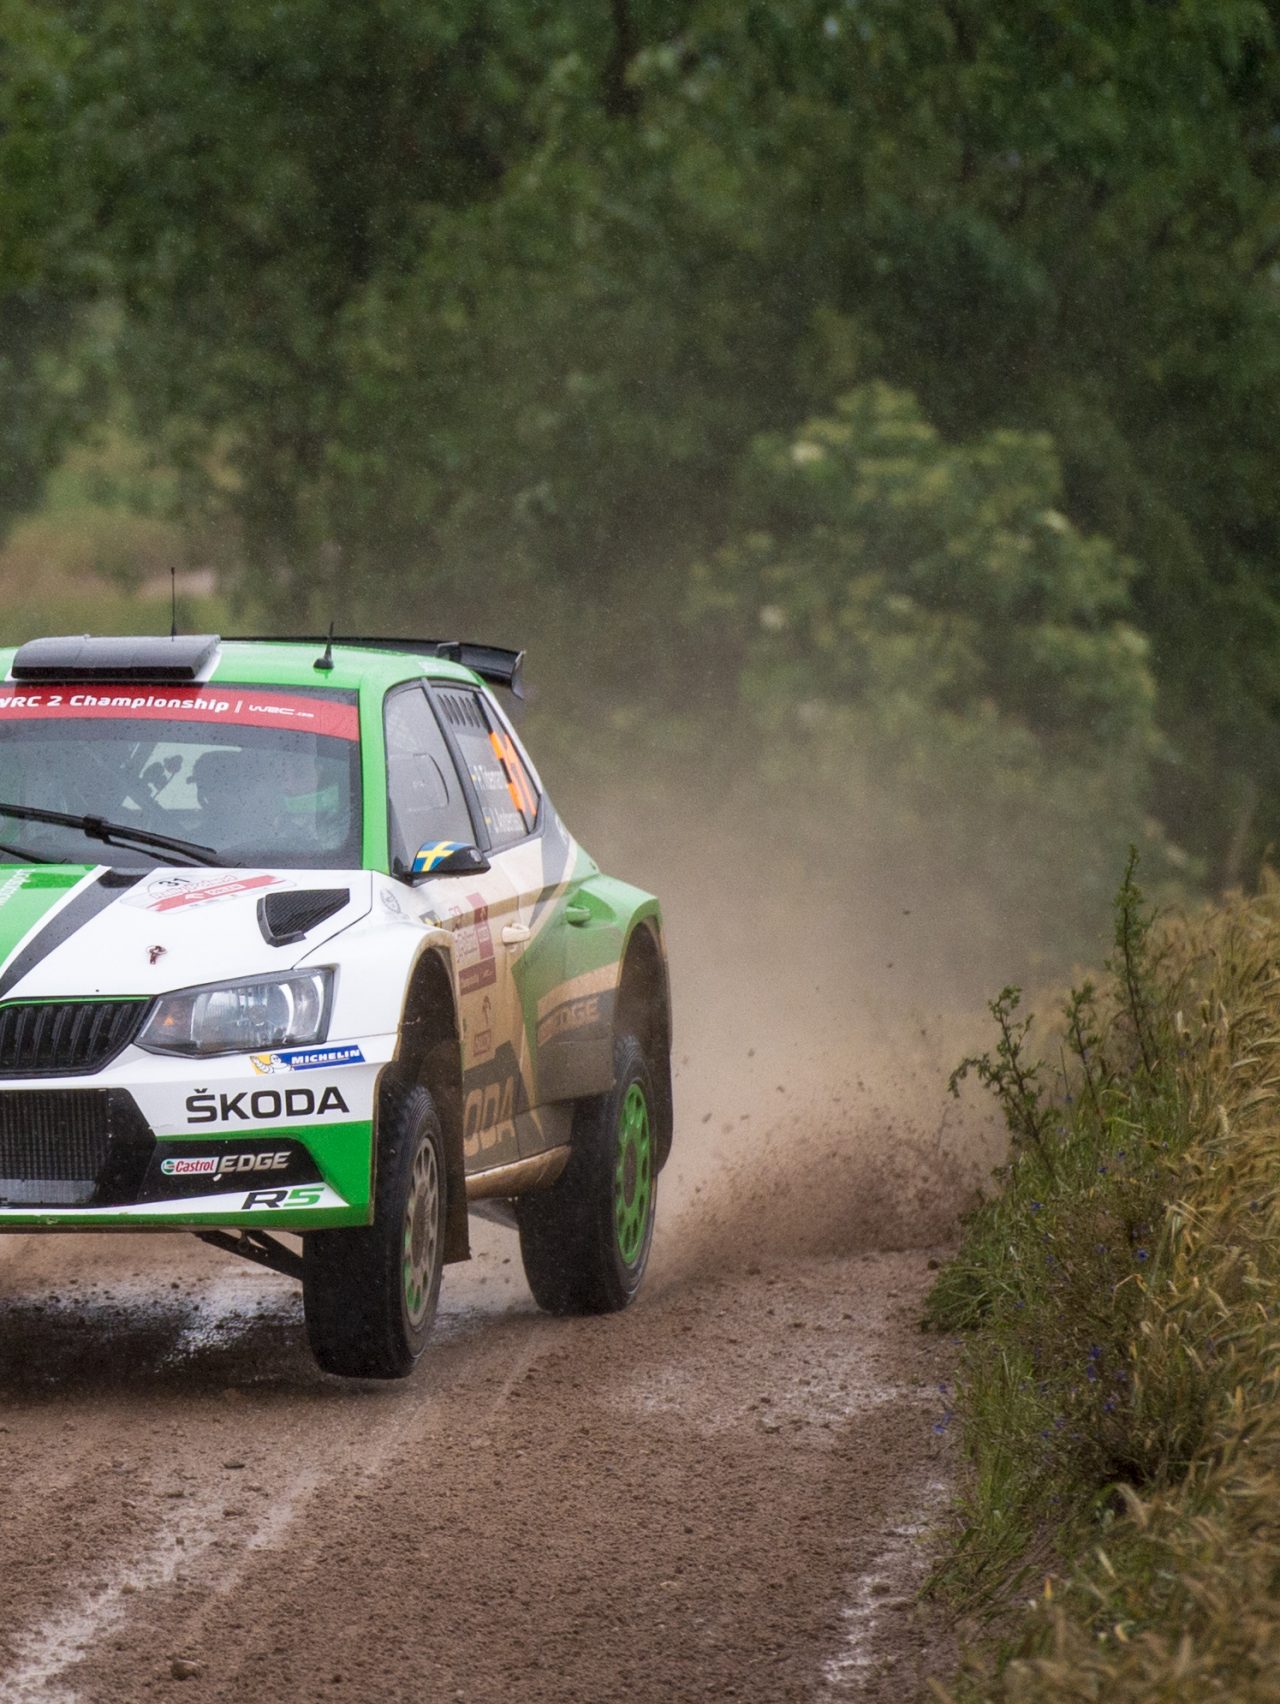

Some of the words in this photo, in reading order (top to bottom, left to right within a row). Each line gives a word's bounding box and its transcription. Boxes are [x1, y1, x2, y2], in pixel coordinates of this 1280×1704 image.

[47, 695, 63, 707] 2
[70, 695, 230, 713] Championship
[291, 1049, 360, 1064] MICHELIN
[185, 1086, 350, 1124] ŠKODA
[463, 1075, 516, 1157] ODA
[175, 1158, 215, 1174] Castrol
[219, 1151, 292, 1174] EDGE
[240, 1187, 326, 1211] R5
